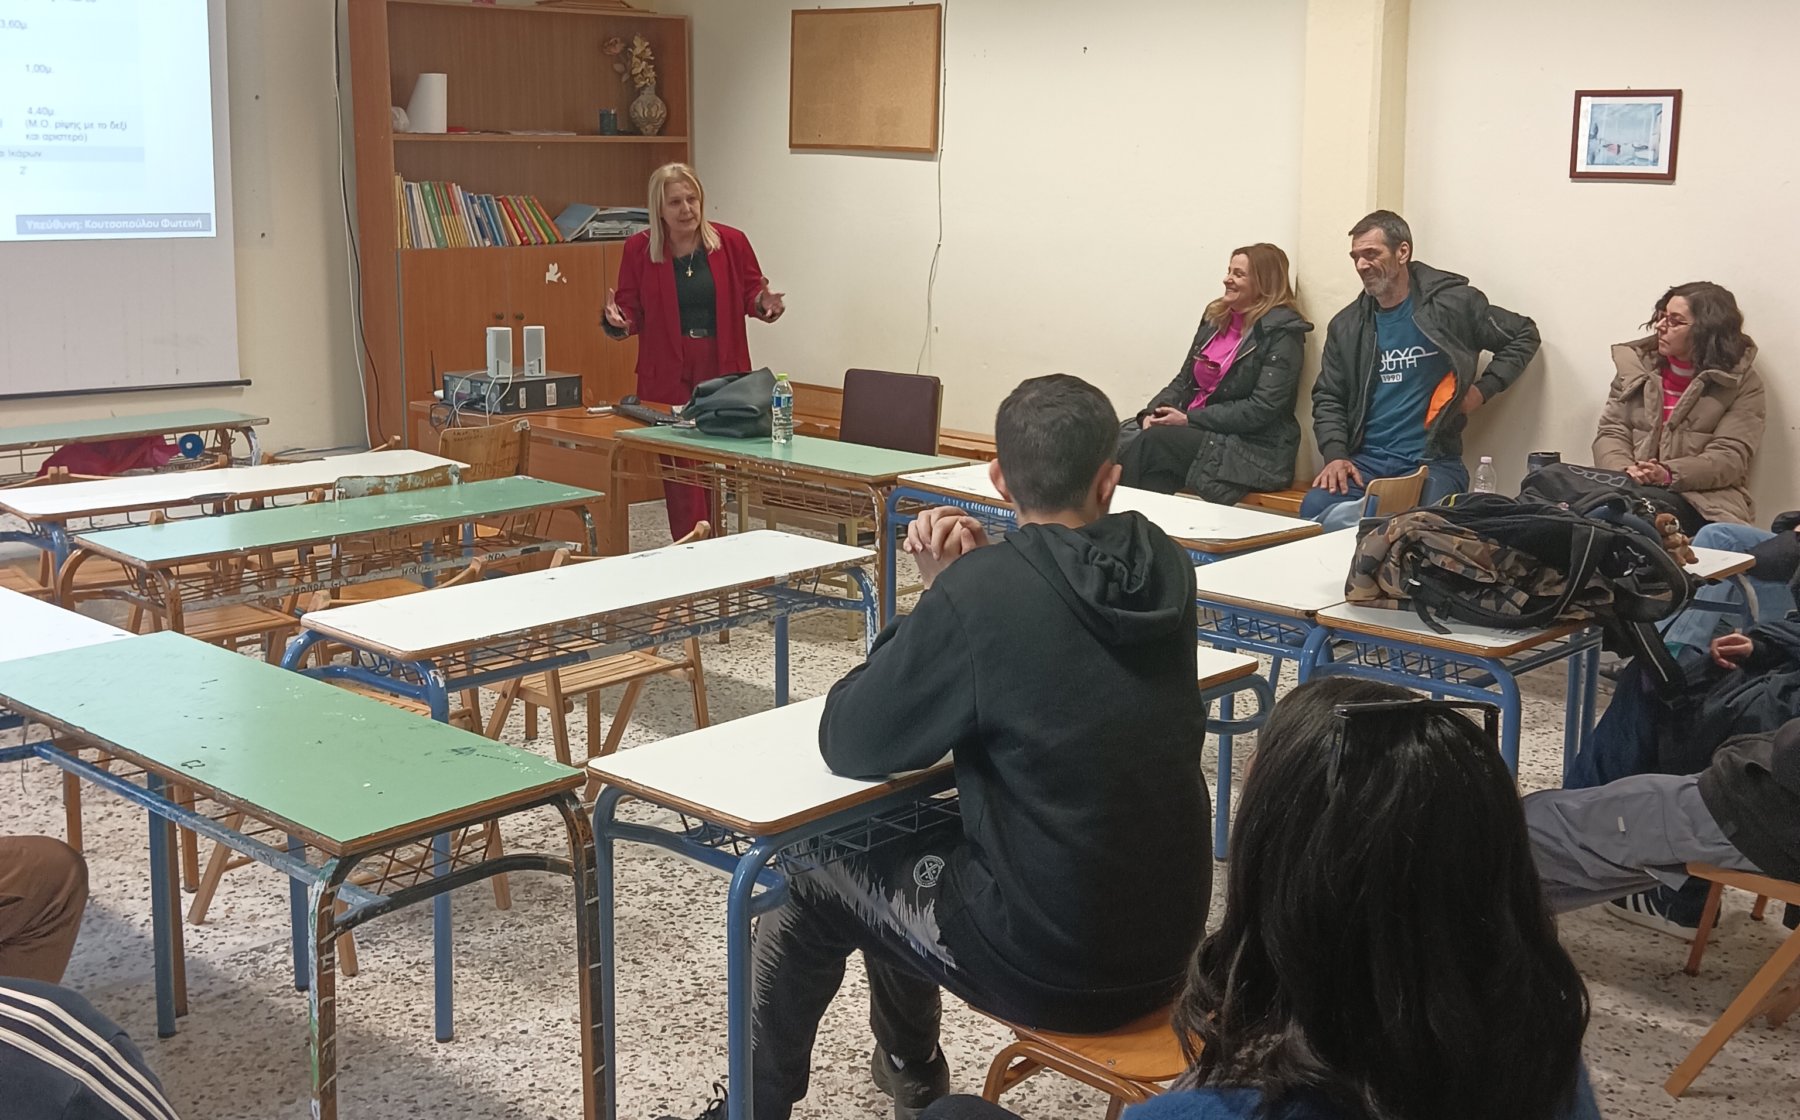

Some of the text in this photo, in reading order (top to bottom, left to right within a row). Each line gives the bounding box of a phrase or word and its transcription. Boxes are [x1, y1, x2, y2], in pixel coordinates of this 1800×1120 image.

[84, 122, 94, 131] με
[97, 122, 107, 130] το
[85, 219, 159, 230] Κουτσοπούλου
[161, 218, 203, 230] Φωτεινή
[293, 581, 326, 594] HONDA
